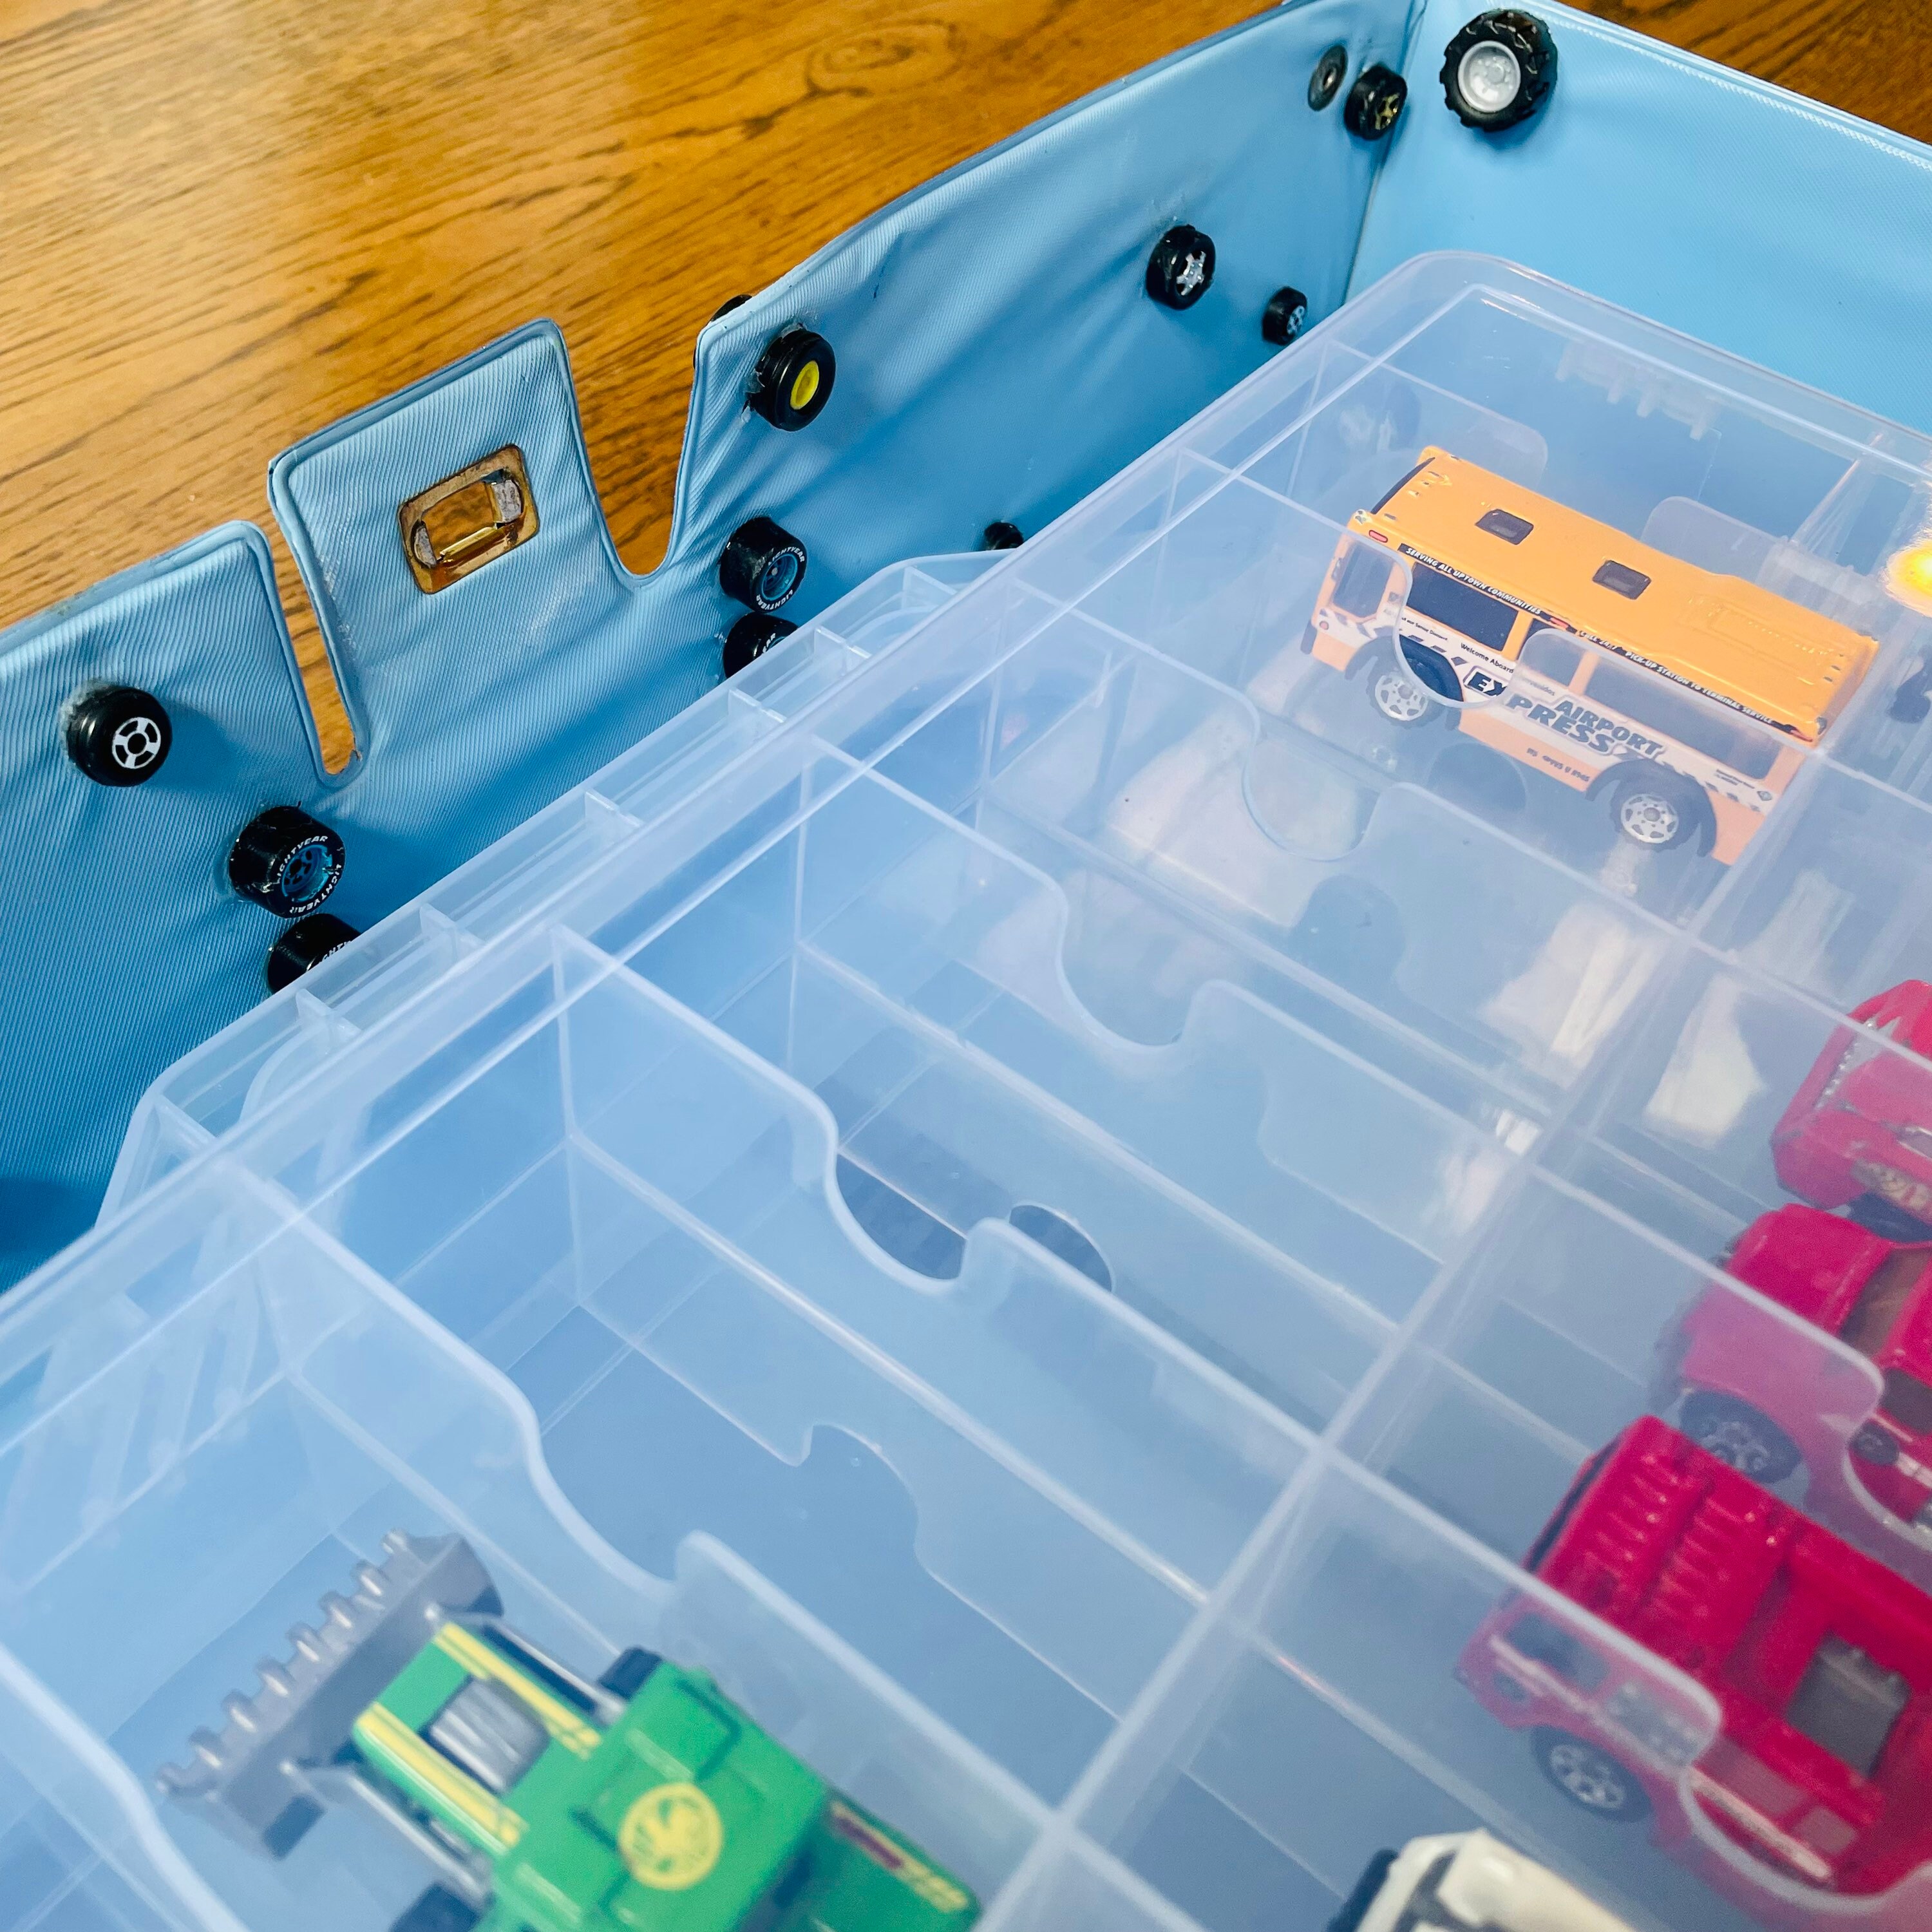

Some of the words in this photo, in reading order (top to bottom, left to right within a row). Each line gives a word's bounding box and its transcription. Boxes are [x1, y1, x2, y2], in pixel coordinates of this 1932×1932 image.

[768, 546, 805, 566] LIGHTYEAR
[1406, 547, 1439, 567] SERVING
[1438, 563, 1453, 574] ALL
[1453, 570, 1486, 591] UPTOWN
[1488, 586, 1542, 615] COMMUNITIES
[1461, 642, 1489, 662] Welcome
[1490, 658, 1513, 674] Aboard
[1625, 651, 1658, 669] PICK-UP
[1656, 666, 1690, 685] STATION
[1690, 682, 1702, 690] TO
[1702, 688, 1741, 709] TERMINAL
[1554, 700, 1663, 756] AIRPORT
